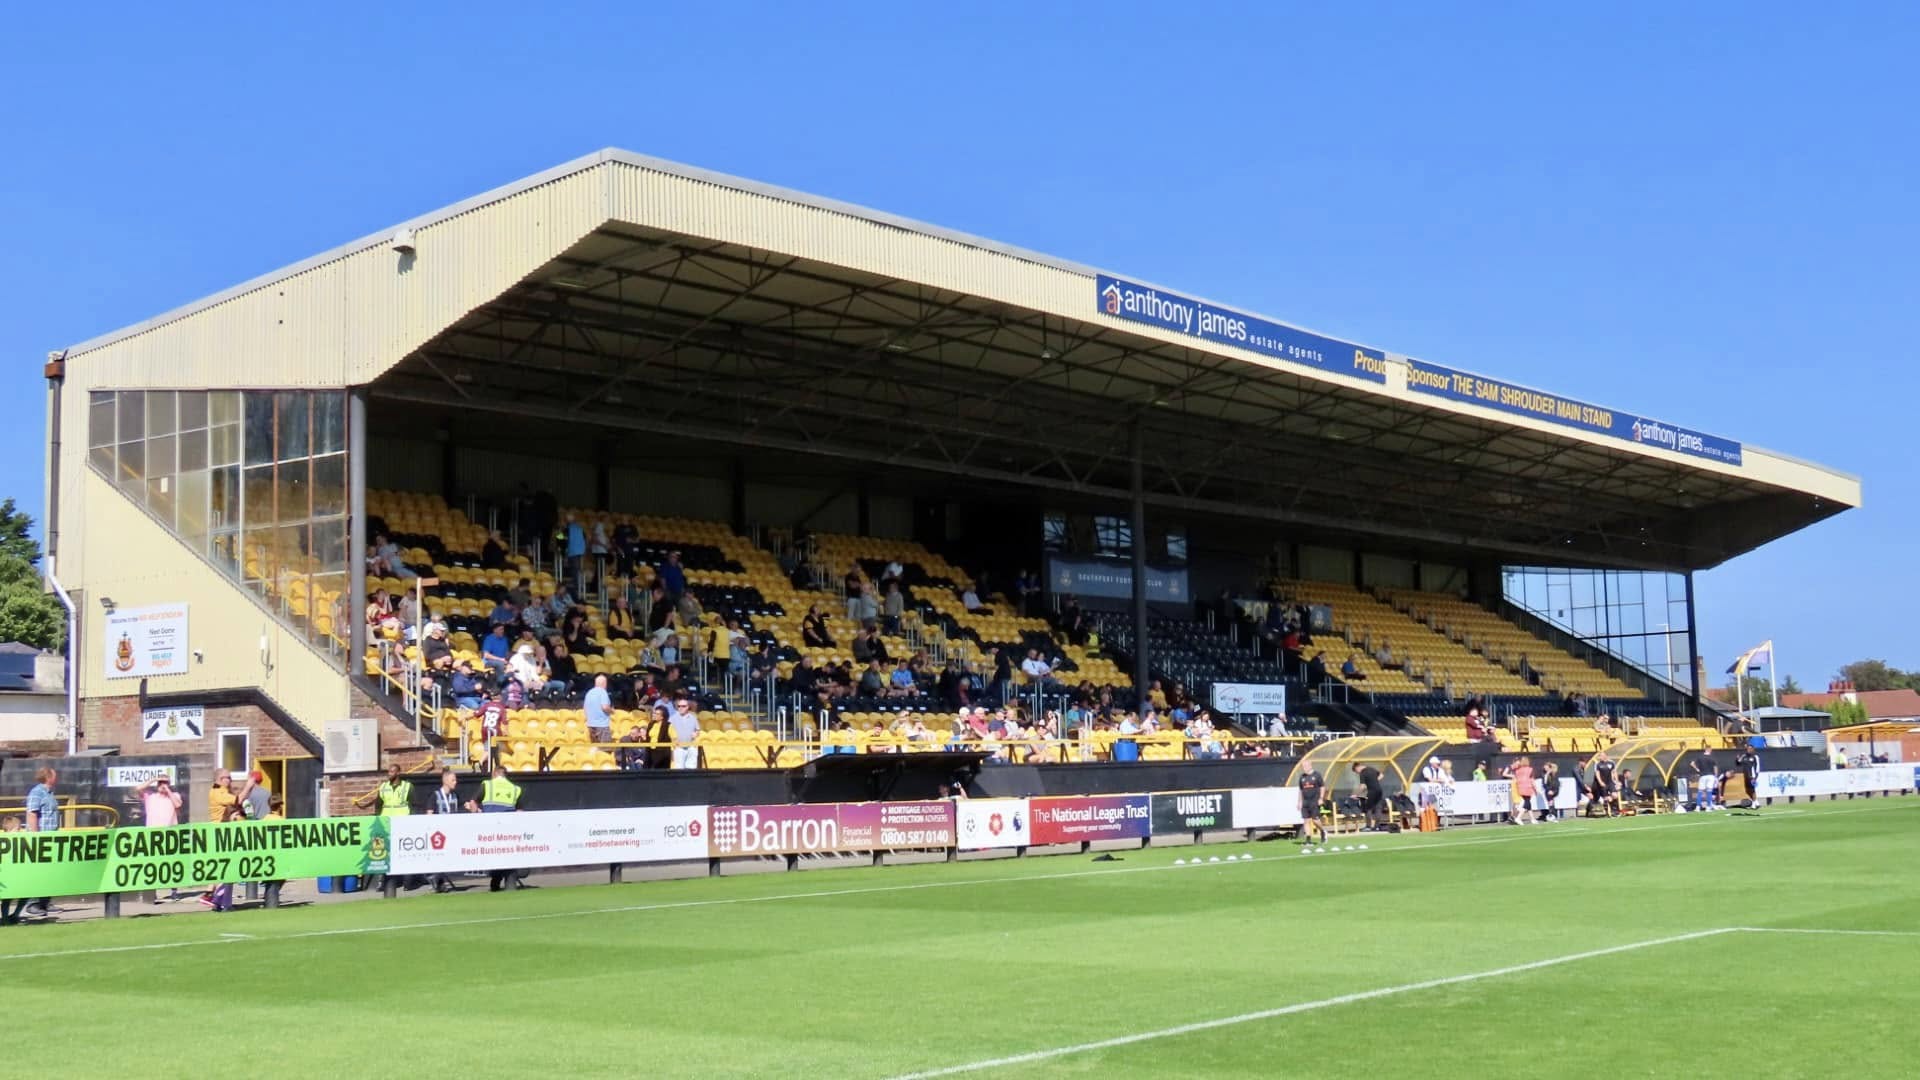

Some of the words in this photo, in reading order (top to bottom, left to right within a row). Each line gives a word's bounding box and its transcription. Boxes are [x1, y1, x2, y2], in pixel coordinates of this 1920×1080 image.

[1124, 288, 1193, 333] anthony
[1196, 304, 1247, 342] james
[1250, 334, 1284, 352] estate
[1288, 344, 1323, 363] agents
[1452, 374, 1473, 396] THE
[1475, 380, 1499, 401] SAM
[1501, 386, 1556, 415] SHROUDER
[1557, 401, 1581, 421] MAIN
[1582, 408, 1613, 429] STAND
[1642, 423, 1676, 450] anthony
[1677, 428, 1703, 451] james
[1116, 576, 1132, 585] FOOT
[145, 712, 167, 720] LADIES
[180, 710, 202, 718] GENTS
[483, 711, 500, 728] 18
[888, 806, 920, 814] MORTGAGE
[1176, 794, 1222, 816] UNIBET
[888, 815, 924, 824] PROTECTION
[1033, 808, 1050, 824] The
[1051, 806, 1092, 823] National
[1093, 806, 1125, 824] League
[1126, 804, 1148, 819] Trust
[588, 828, 608, 837] Learn
[609, 828, 627, 836] more
[628, 827, 635, 835] at
[664, 822, 688, 838] real
[740, 808, 837, 852] Barron
[842, 826, 872, 836] Financial
[1062, 825, 1088, 833] Supporting
[1098, 823, 1122, 831] community
[0, 834, 108, 864] PINETREE
[115, 829, 208, 859] GARDEN
[215, 822, 362, 852] MAINTENANCE
[398, 831, 428, 852] real
[478, 834, 495, 842] Real
[496, 832, 522, 843] Money
[523, 832, 534, 840] for
[842, 836, 873, 847] Solutions
[881, 832, 906, 846] 0800
[908, 830, 924, 844] 587
[926, 830, 949, 844] 0140
[461, 847, 478, 856] Real
[480, 846, 514, 856] Business
[516, 844, 550, 852] Referrals
[115, 862, 184, 888] 07909
[192, 858, 231, 882] 827
[239, 856, 276, 879] 023
